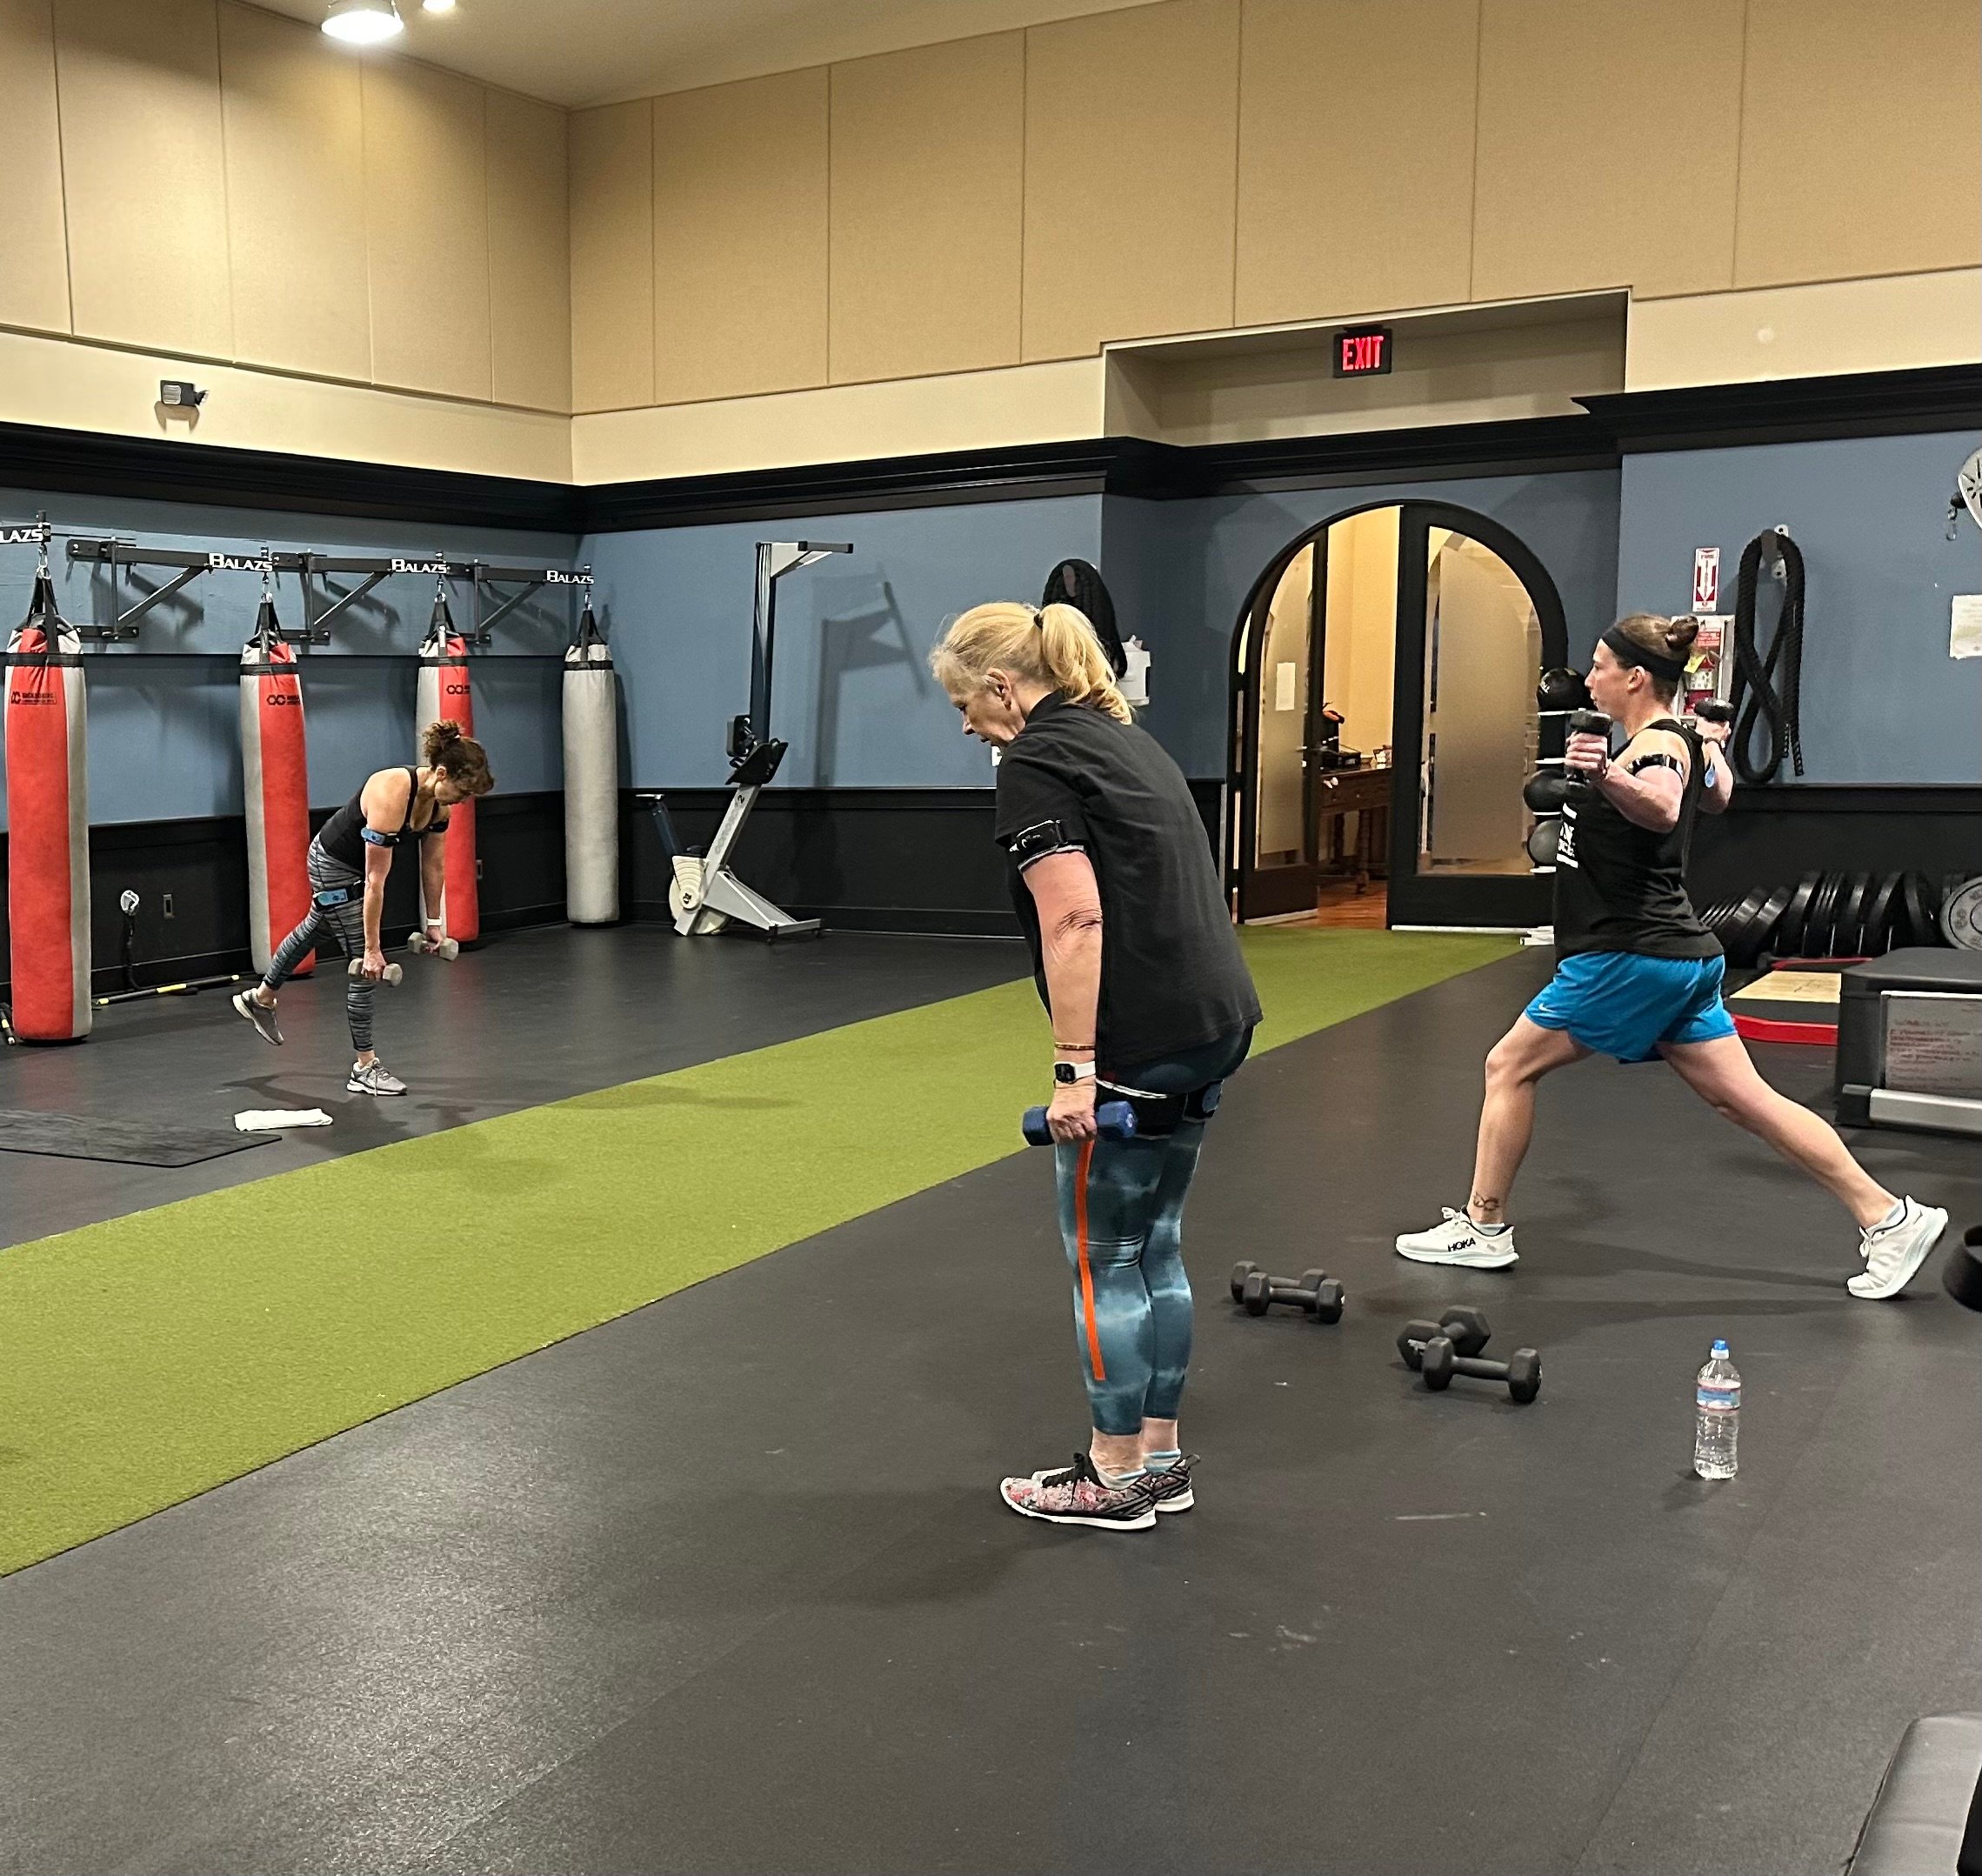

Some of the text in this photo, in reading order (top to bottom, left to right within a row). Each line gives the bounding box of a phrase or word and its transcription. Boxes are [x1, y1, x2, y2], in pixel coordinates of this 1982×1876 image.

[1343, 336, 1384, 371] EXIT
[209, 552, 273, 572] BALAZS
[391, 558, 447, 574] BALAZS
[546, 570, 595, 584] BALAZS
[1447, 1237, 1476, 1252] HOKA
